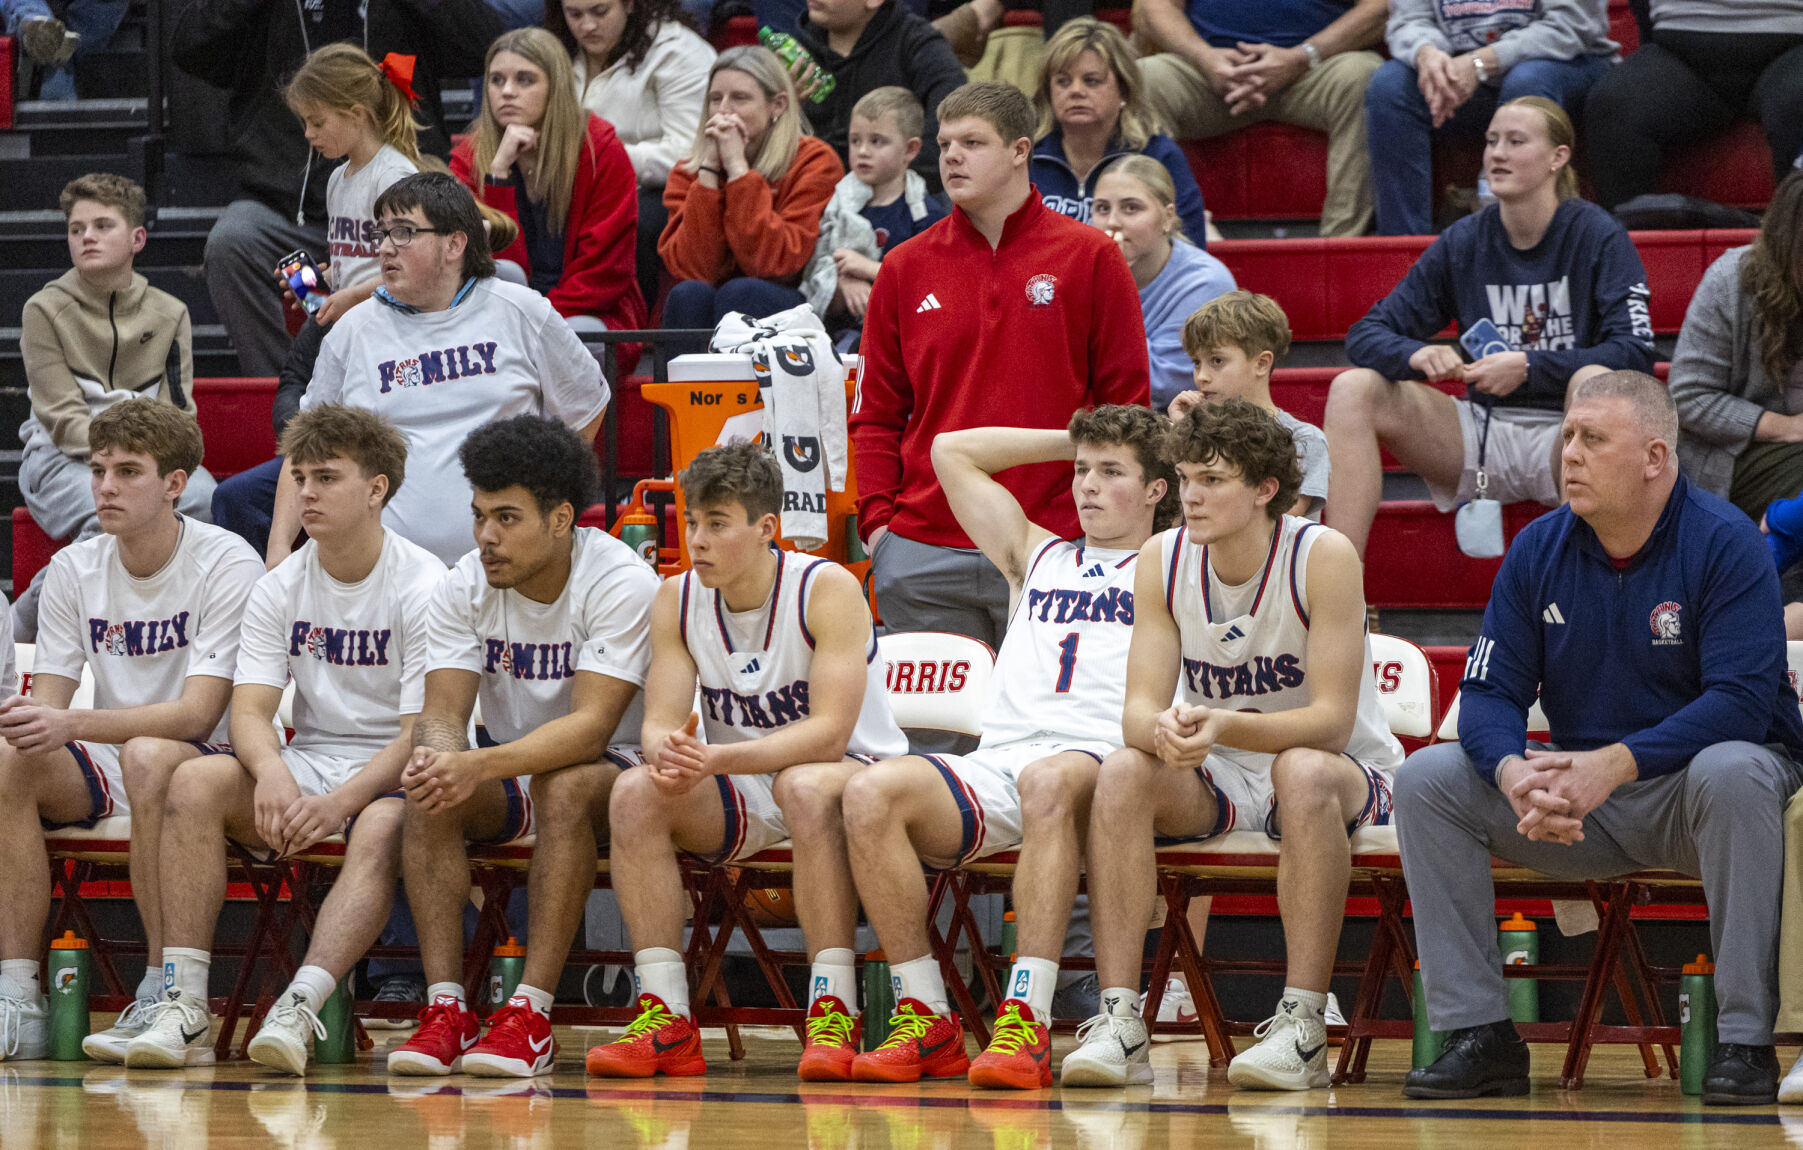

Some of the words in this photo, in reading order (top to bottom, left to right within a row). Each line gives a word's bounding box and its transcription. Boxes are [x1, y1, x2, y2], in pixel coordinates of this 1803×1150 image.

[1485, 275, 1572, 325] WIN
[1497, 325, 1522, 344] OR
[1540, 316, 1574, 338] HE
[1028, 587, 1135, 627] TITANS
[1650, 600, 1682, 635] TITANS
[1055, 632, 1080, 693] 1
[1183, 653, 1306, 700] TITANS
[700, 680, 810, 729] TITANS
